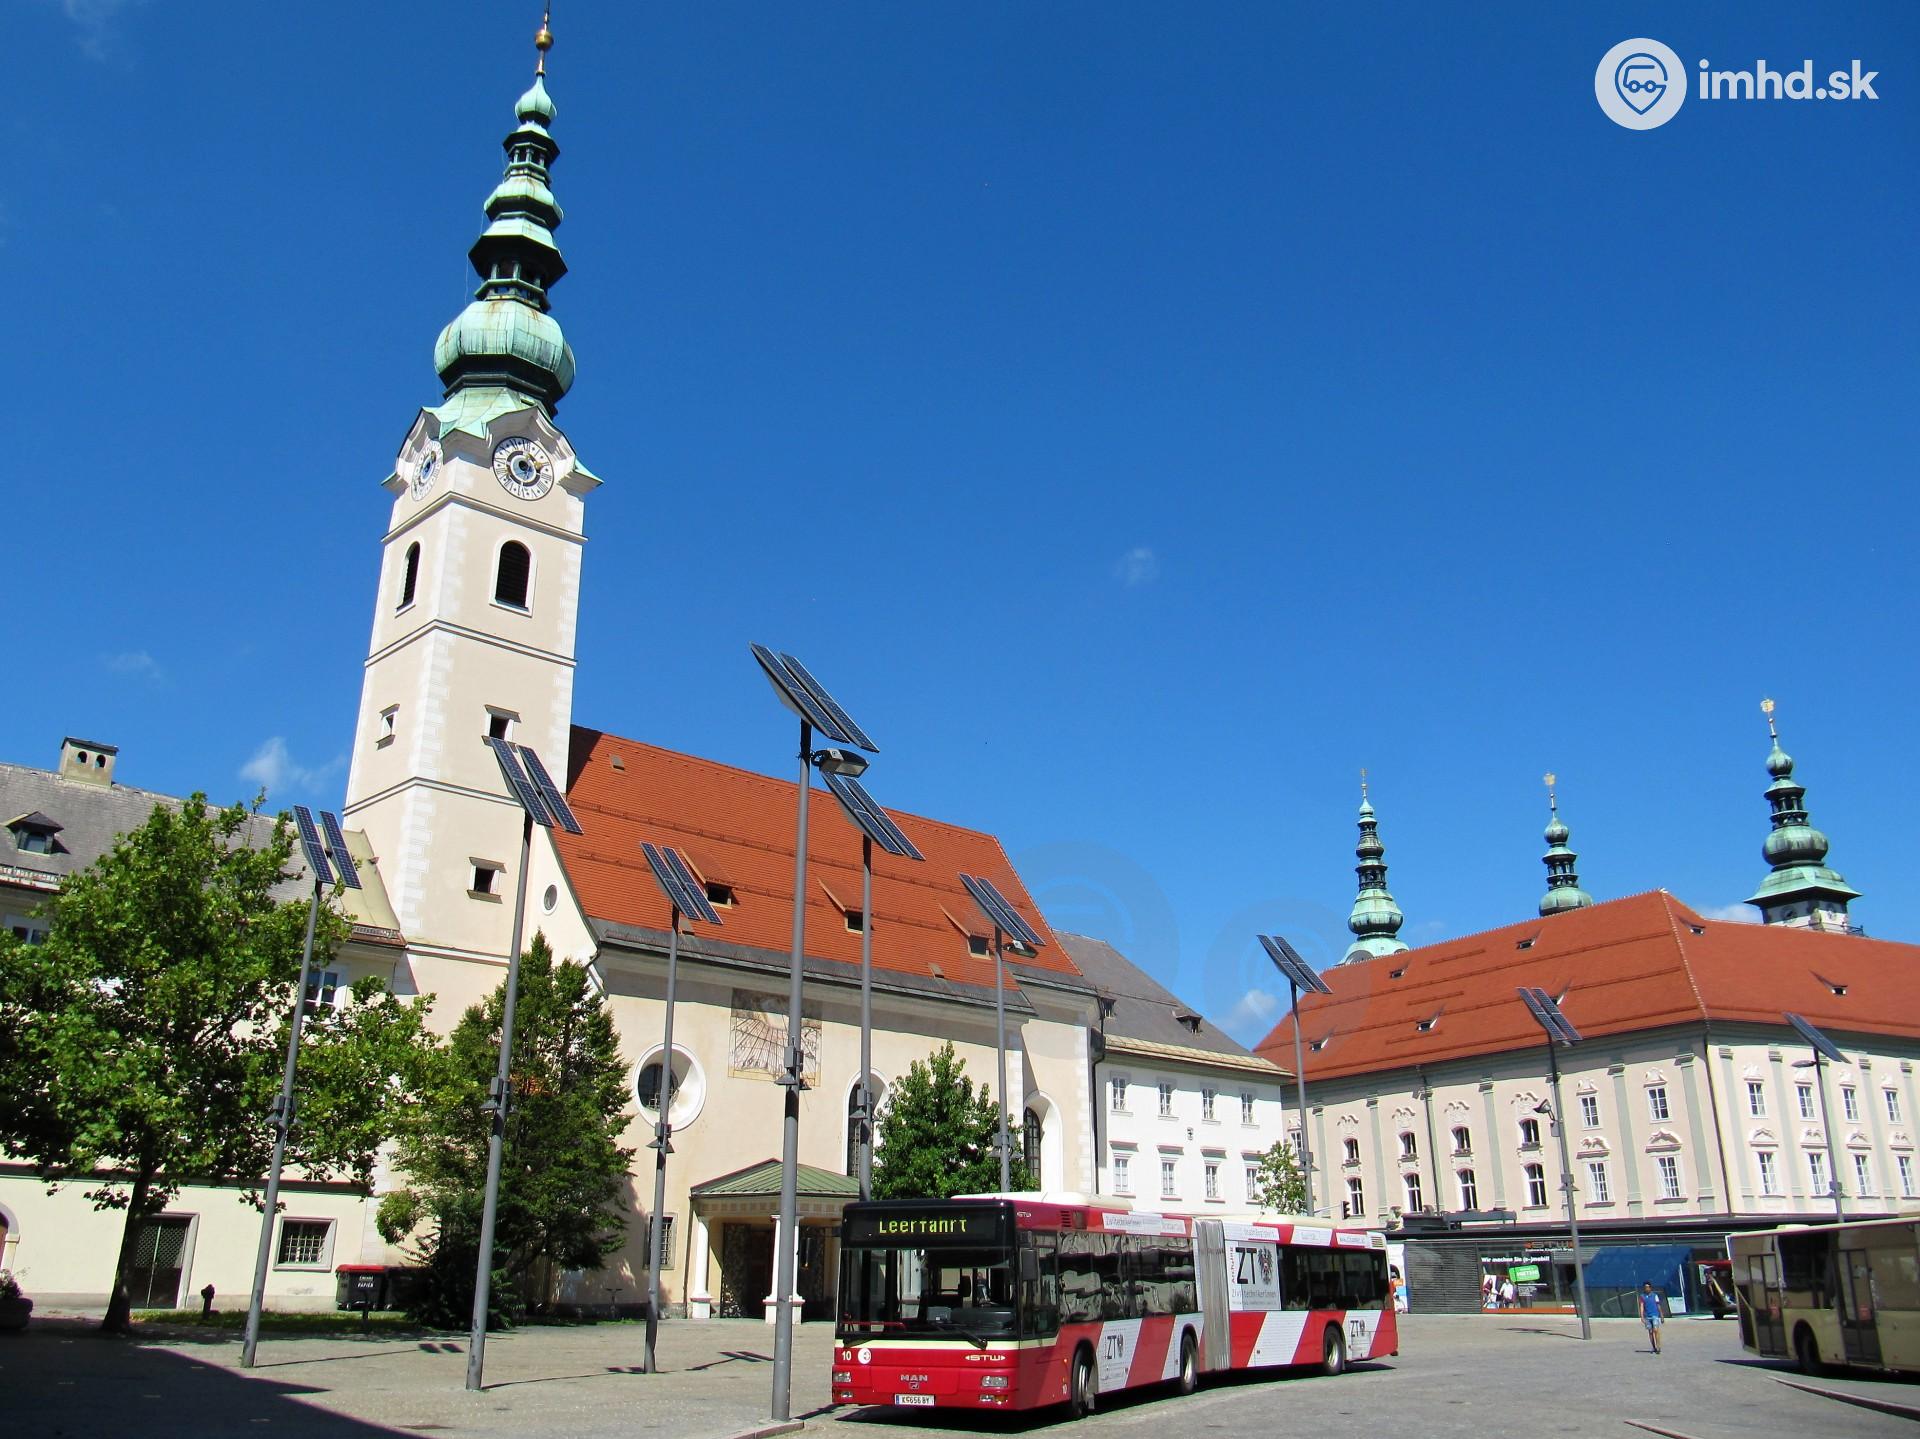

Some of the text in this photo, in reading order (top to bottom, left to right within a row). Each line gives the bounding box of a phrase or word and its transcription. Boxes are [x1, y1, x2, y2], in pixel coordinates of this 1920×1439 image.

[879, 1216, 967, 1234] Leerfahrt
[1235, 1247, 1257, 1285] ZT
[841, 1350, 852, 1361] 10
